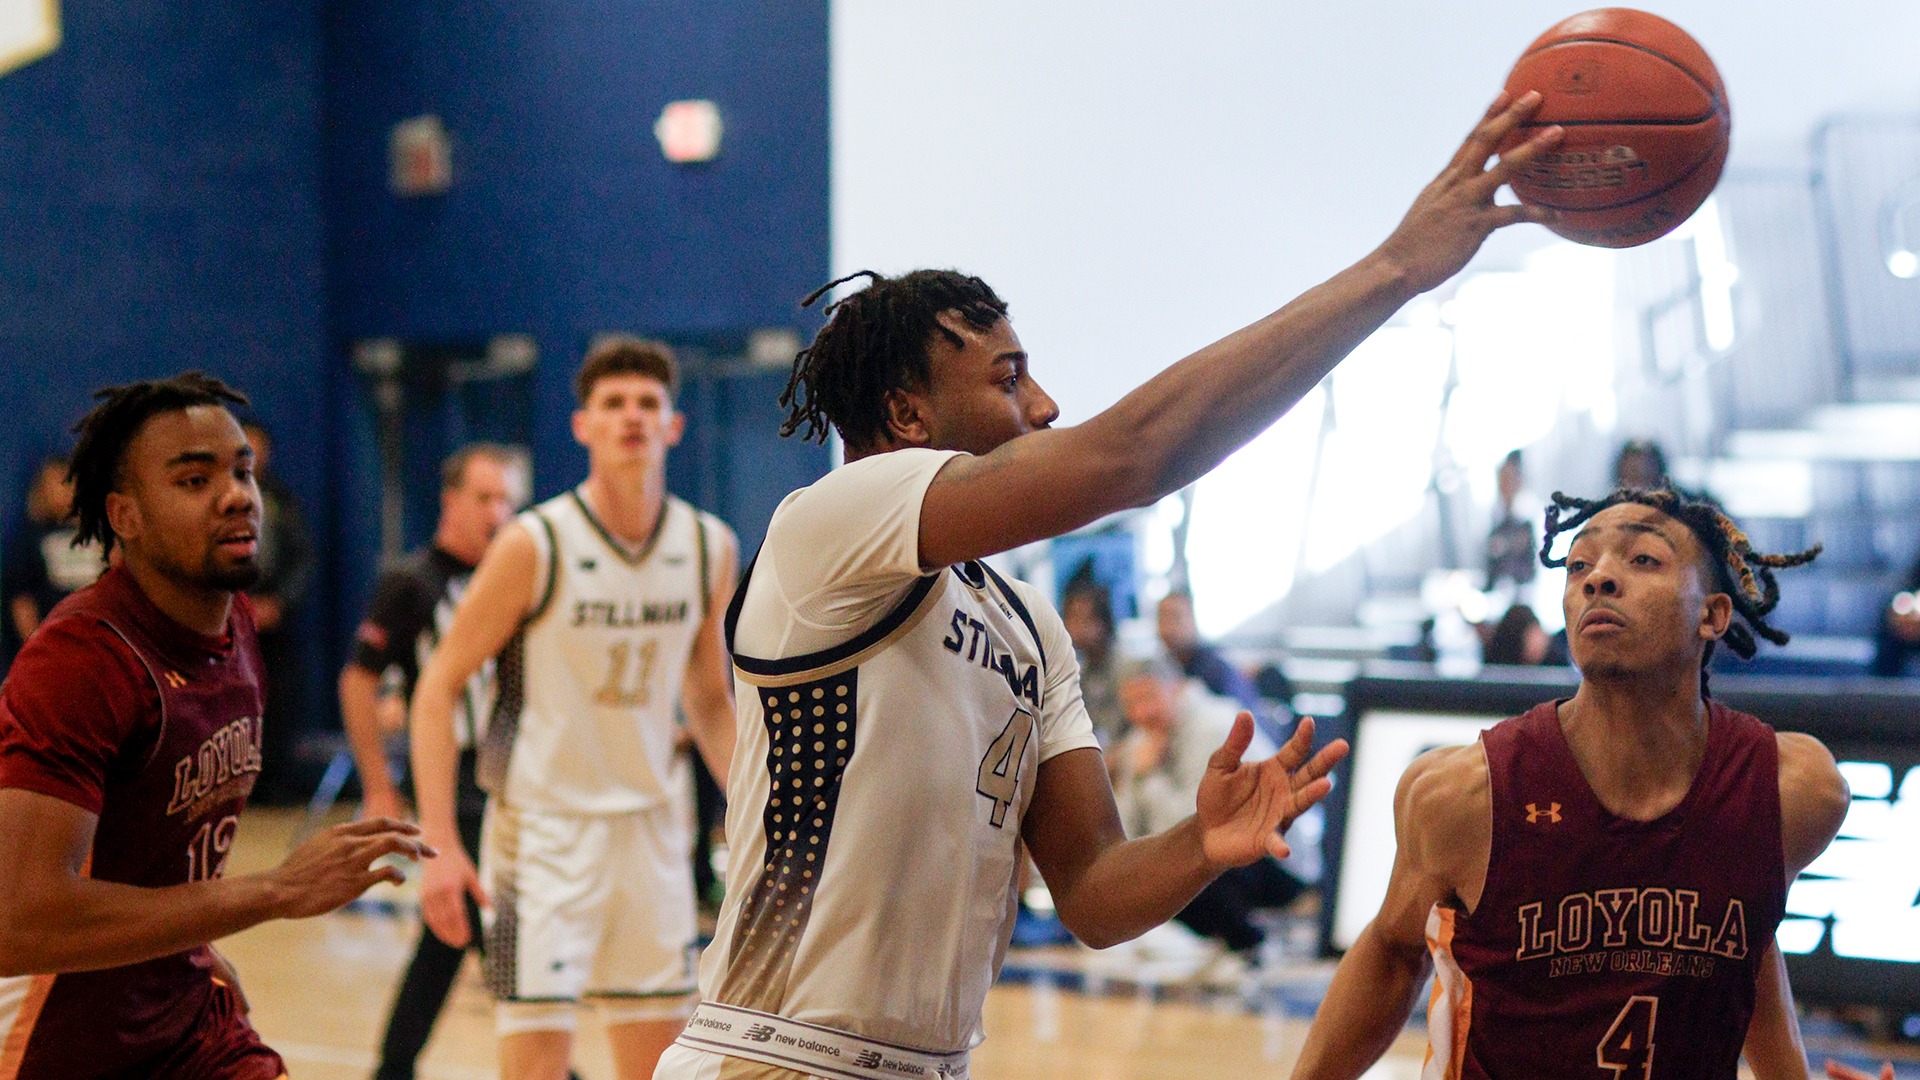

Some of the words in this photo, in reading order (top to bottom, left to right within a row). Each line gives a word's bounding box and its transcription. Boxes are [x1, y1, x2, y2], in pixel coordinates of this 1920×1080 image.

[976, 707, 1034, 828] 4
[1516, 888, 1749, 961] LOYOLA
[1549, 951, 1607, 978] NEW
[1610, 950, 1716, 978] ORLEANS
[775, 1033, 798, 1046] new
[797, 1037, 841, 1057] balance
[1596, 995, 1659, 1080] 4
